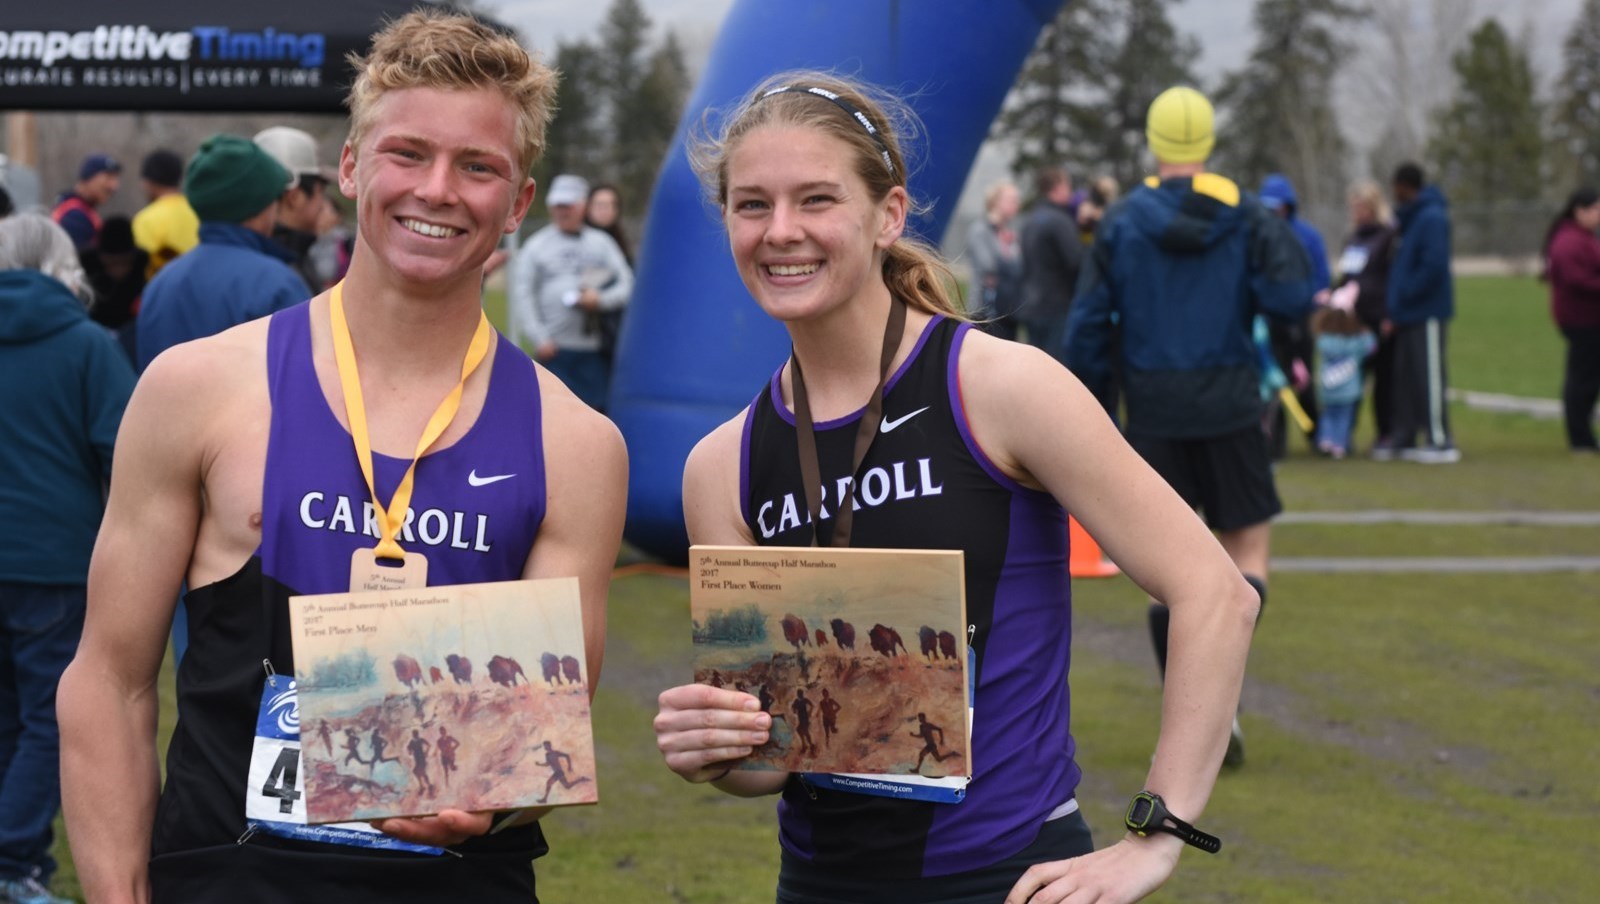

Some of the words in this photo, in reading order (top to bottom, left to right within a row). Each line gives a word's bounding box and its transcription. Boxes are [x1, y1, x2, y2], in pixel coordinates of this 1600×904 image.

[193, 26, 326, 67] Timing
[0, 67, 75, 87] URATE
[83, 67, 178, 87] RESULTS
[193, 67, 261, 88] EVERY
[269, 67, 322, 88] TIME
[808, 87, 840, 100] NIKE
[854, 111, 877, 134] NIKE
[757, 457, 943, 539] CAROLL
[299, 490, 492, 553] CARROLL
[714, 558, 741, 567] Annual
[743, 558, 780, 570] Buttercup
[781, 558, 798, 568] Half
[799, 560, 837, 569] Marathon
[700, 568, 719, 578] 2017
[701, 580, 721, 590] First
[723, 580, 747, 590] Place
[748, 580, 782, 591] Women
[317, 603, 348, 613] Annual
[390, 598, 409, 608] Half
[410, 596, 450, 606] Marathon
[303, 614, 324, 625] 2017
[304, 627, 327, 637] First
[328, 625, 353, 636] Place
[355, 624, 378, 633] Men
[261, 747, 302, 815] 4
[832, 776, 913, 794] www.CompetitiveTiming.com
